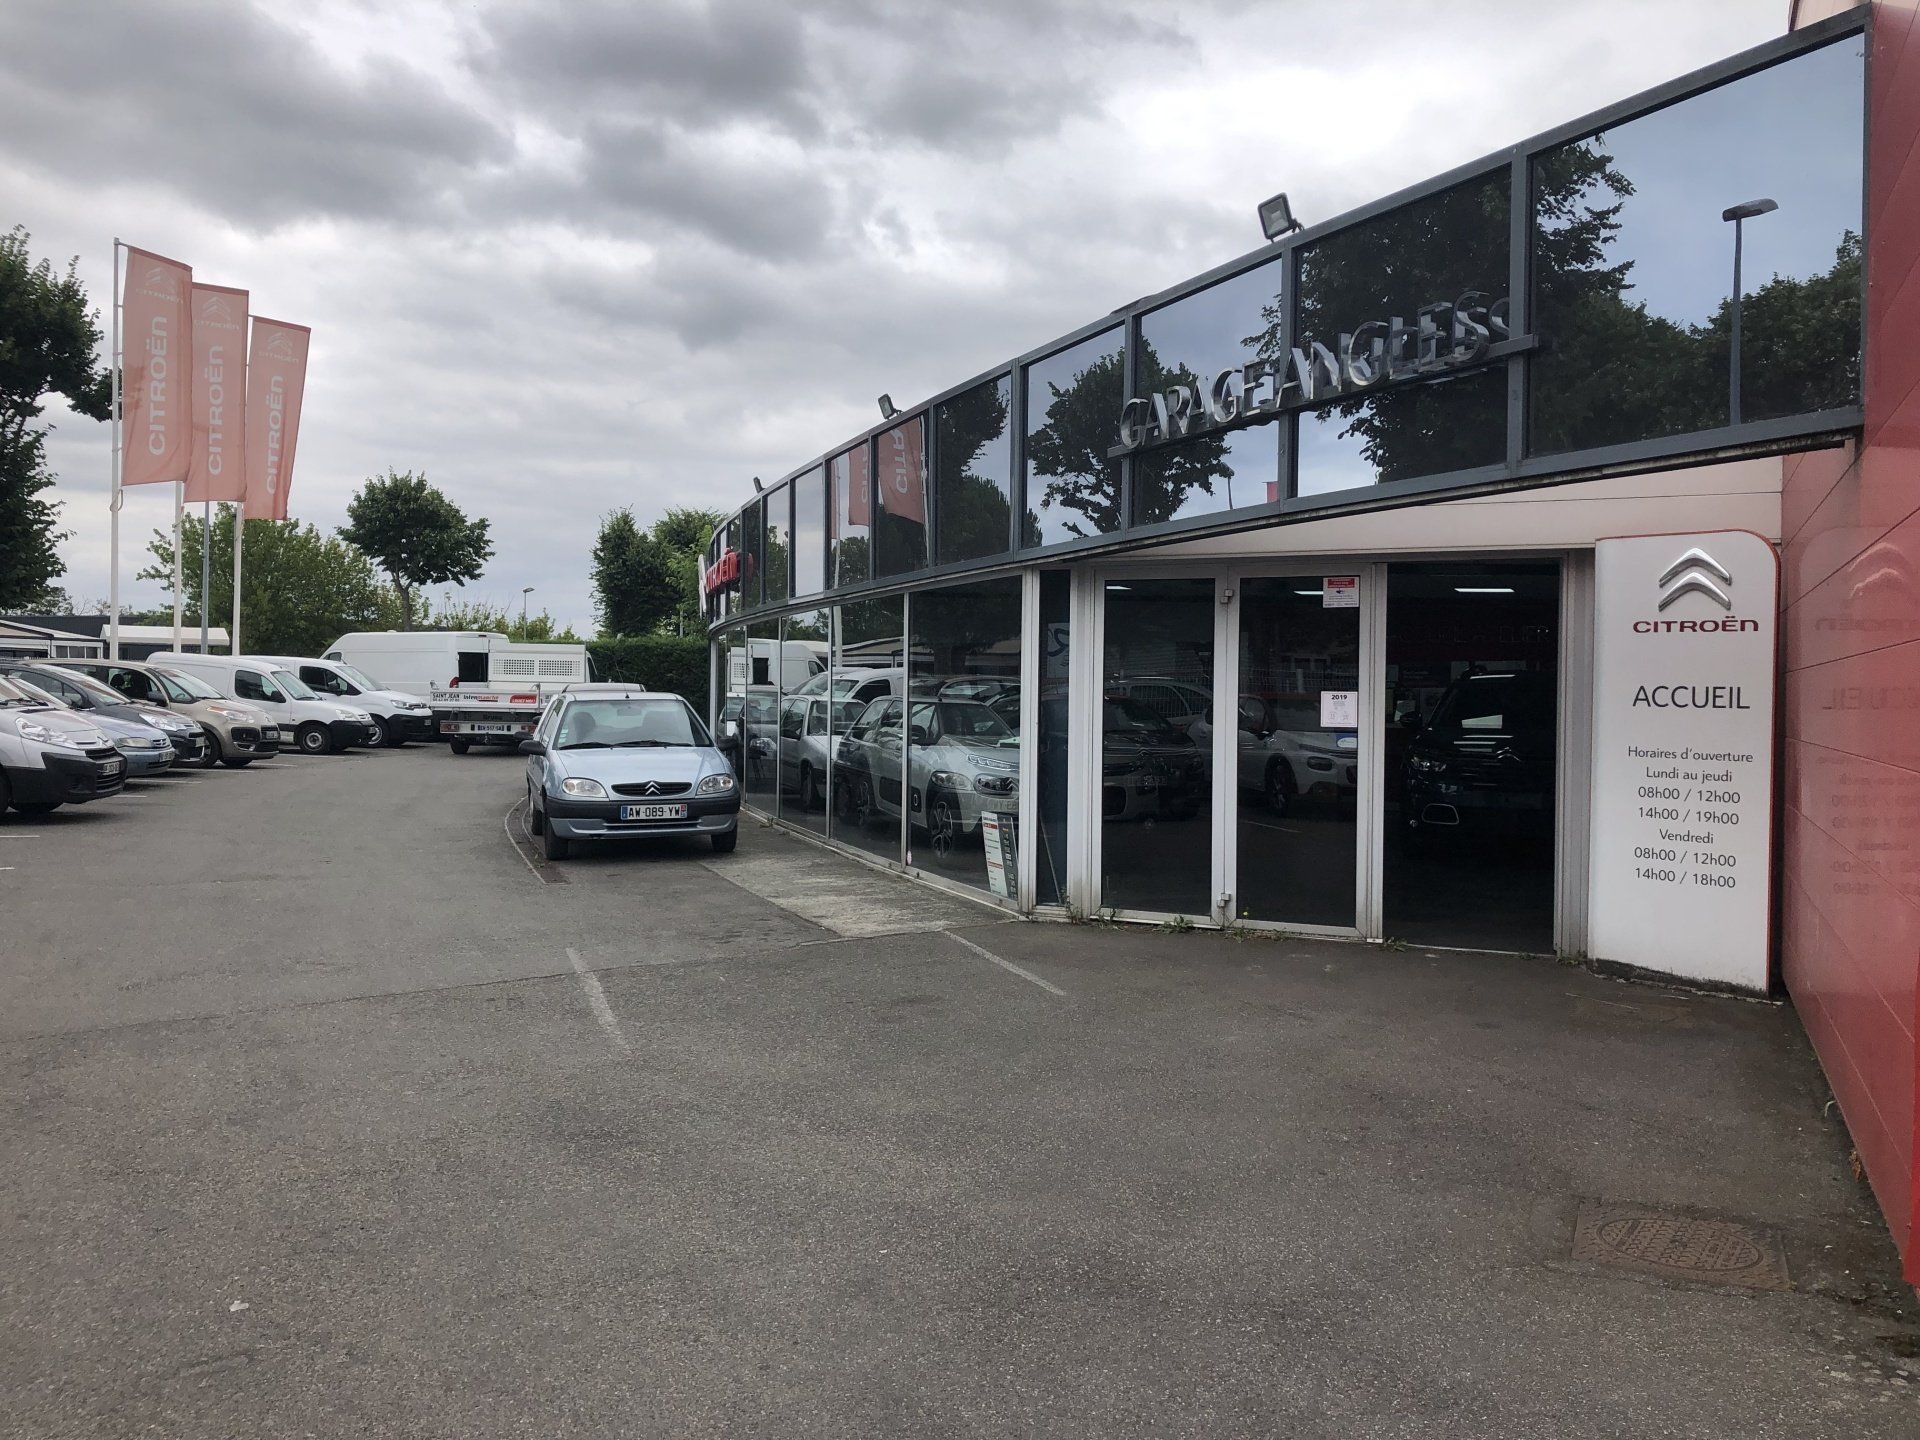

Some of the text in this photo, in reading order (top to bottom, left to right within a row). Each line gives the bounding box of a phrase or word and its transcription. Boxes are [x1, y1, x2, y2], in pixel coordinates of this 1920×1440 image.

[1120, 359, 1264, 449] GARAGE
[1633, 615, 1759, 634] CITROËN
[1632, 686, 1751, 709] ACCUEIL
[1628, 746, 1754, 763] Horaires d'ouverture
[1646, 766, 1733, 784] Lundi au jeudi
[1638, 786, 1741, 804] 08h00 / 12h00
[1638, 807, 1740, 825] 14h00 / 19h00
[1659, 828, 1714, 844] Vendredi
[1634, 846, 1737, 867] 08h00 / 12h00
[1634, 867, 1736, 888] 14h00 / 18h00
